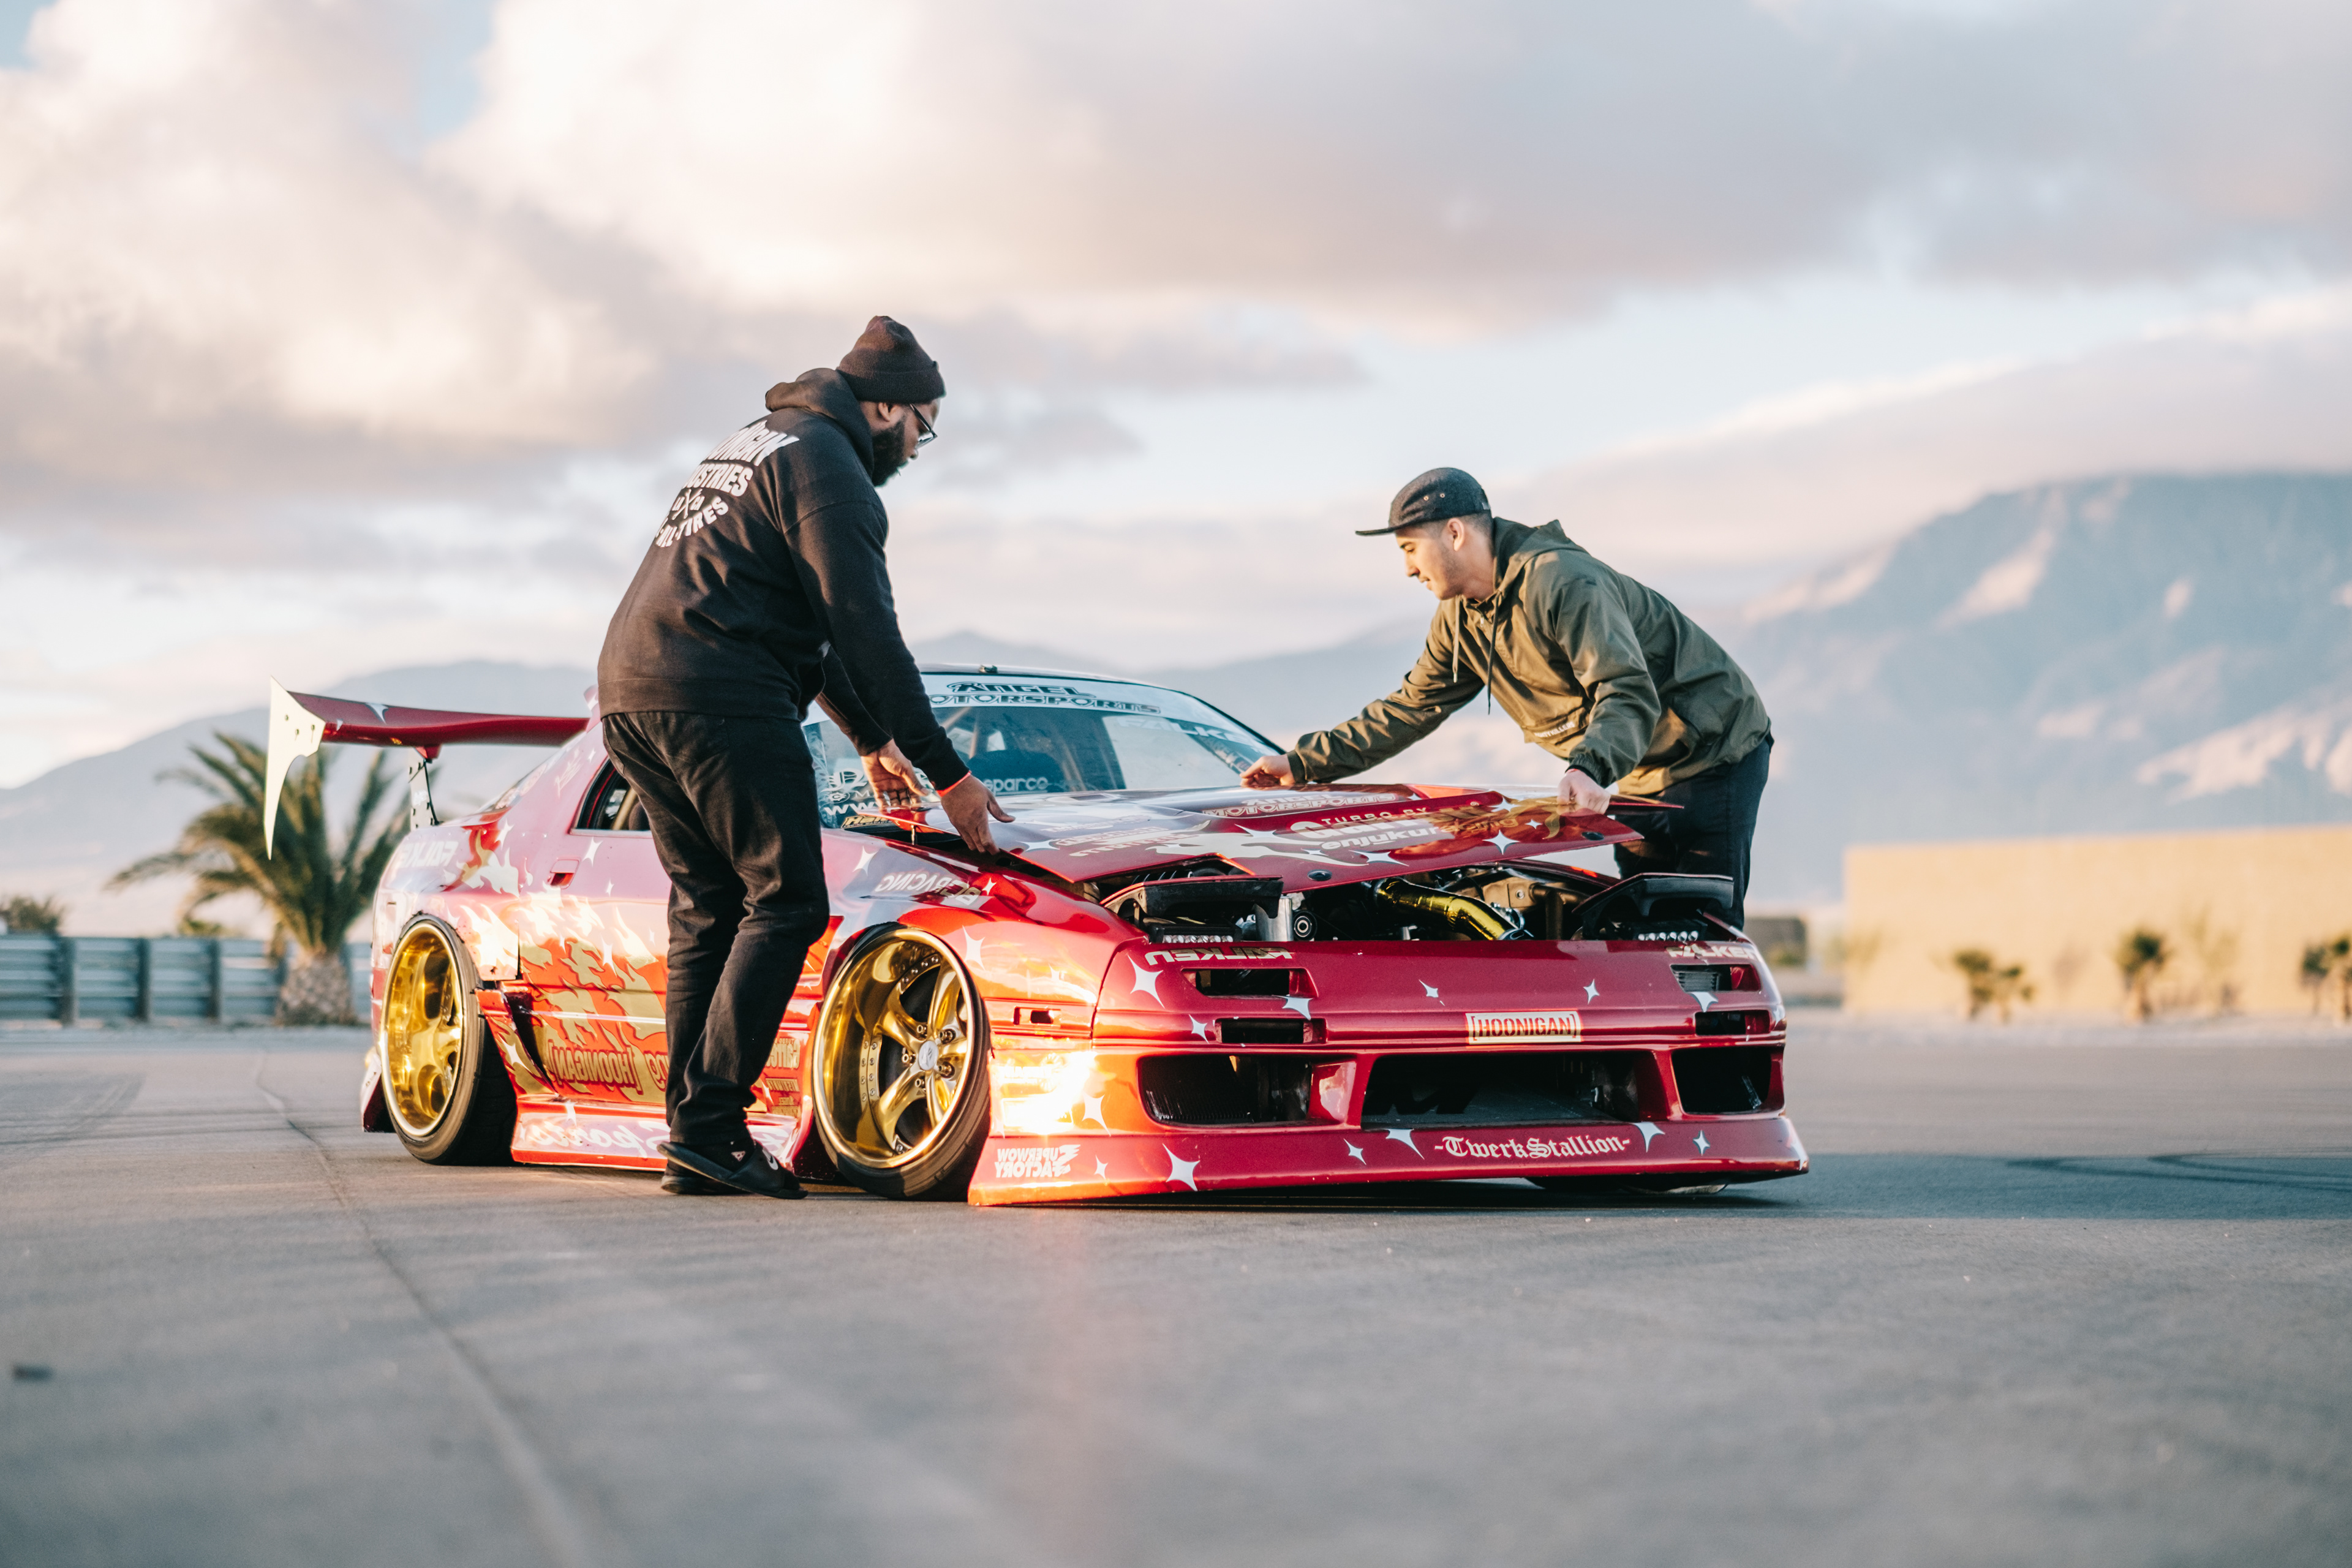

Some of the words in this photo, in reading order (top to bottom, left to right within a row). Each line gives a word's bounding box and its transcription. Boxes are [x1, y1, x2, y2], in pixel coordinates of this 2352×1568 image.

[682, 464, 753, 497] USTRIES
[947, 682, 1096, 698] ANGEL
[930, 695, 1161, 714] OTORSPORTS
[1203, 794, 1396, 816] MOTORSPORTS
[1321, 812, 1392, 825] TURBO
